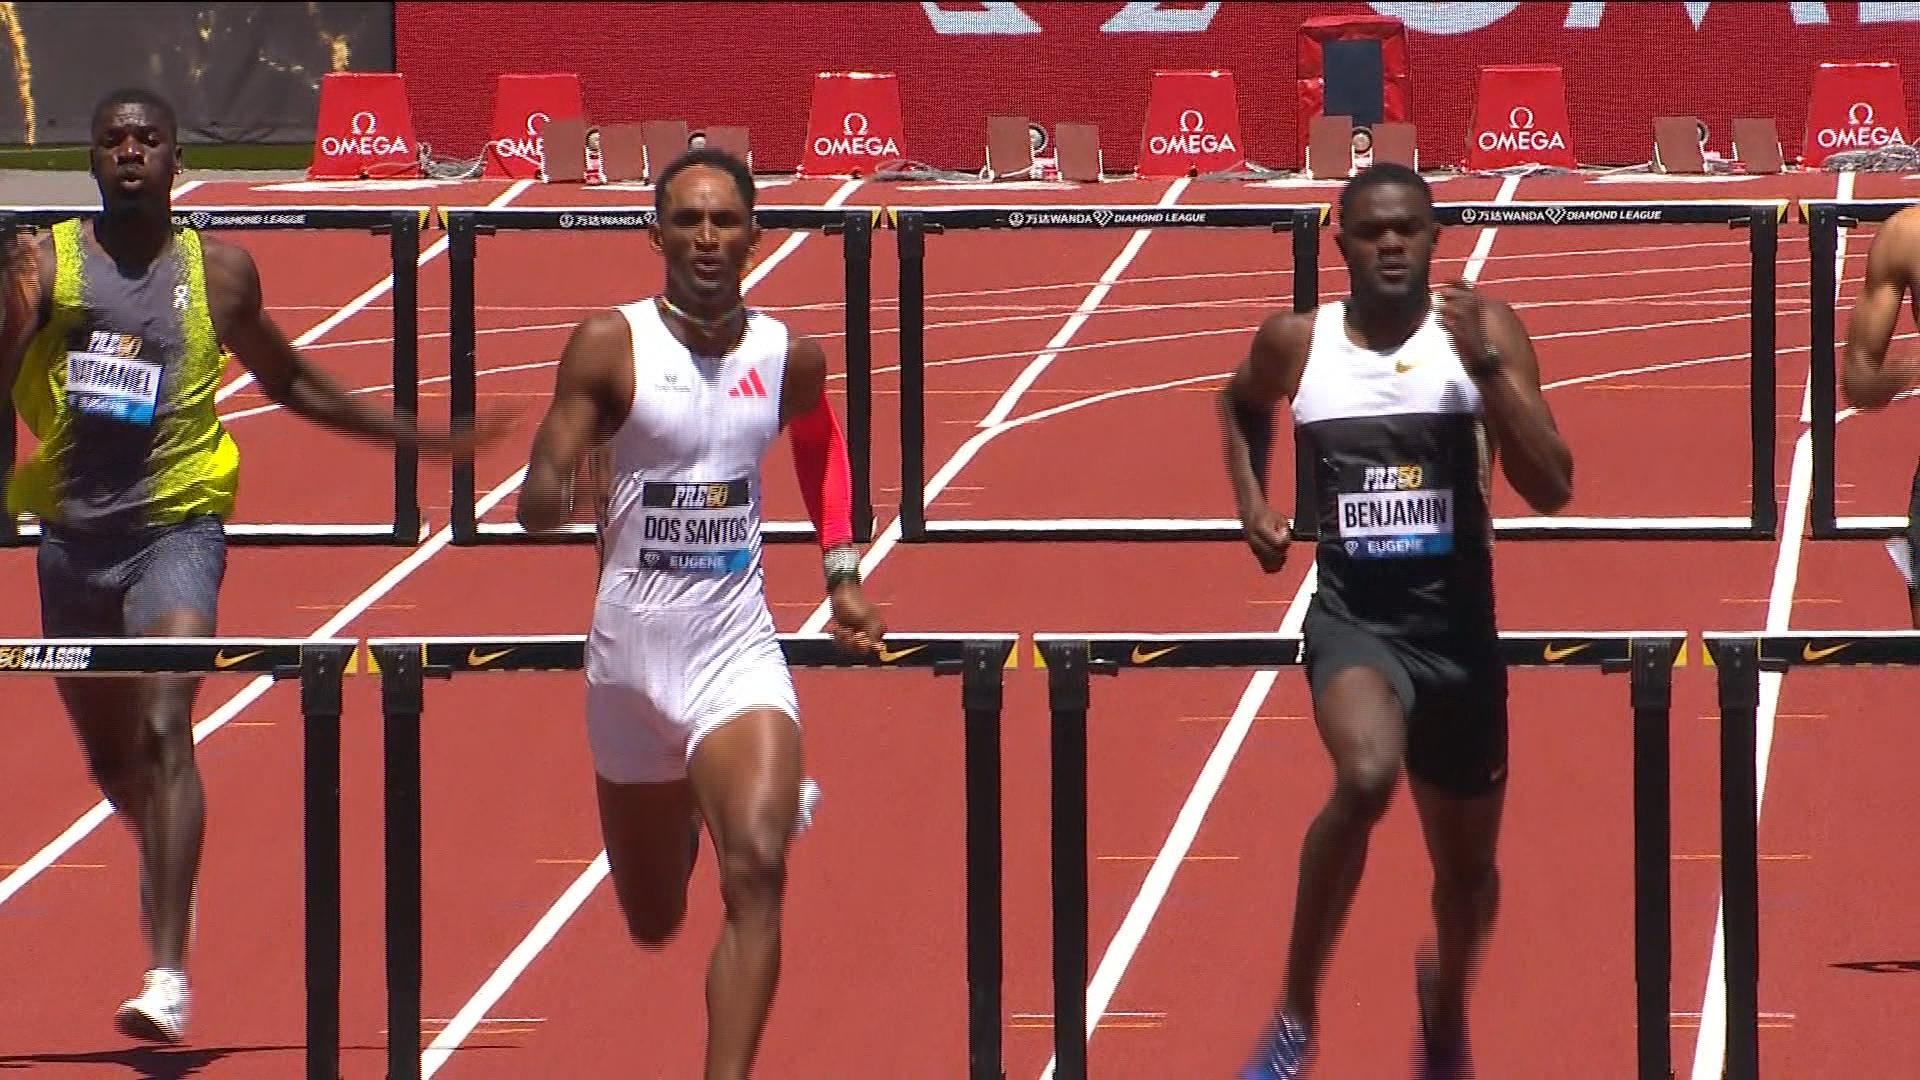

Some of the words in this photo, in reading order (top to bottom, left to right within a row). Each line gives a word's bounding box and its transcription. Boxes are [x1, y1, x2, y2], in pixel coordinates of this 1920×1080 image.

[321, 136, 409, 156] OMEGA
[814, 136, 900, 156] OMEGA
[1149, 134, 1237, 154] OMEGA
[1478, 130, 1566, 151] OMEGA
[1817, 127, 1906, 147] OMEGA
[496, 138, 545, 157] OME
[210, 214, 263, 226] DIAMOND
[263, 213, 306, 225] LEAGUE
[1114, 213, 1163, 223] DIAMOND
[1165, 212, 1206, 223] LEAGUE
[1566, 210, 1617, 221] DIAMOND
[1619, 210, 1662, 220] LEAGUE
[69, 357, 152, 396] NATHANIEL
[1344, 498, 1447, 529] BENJAMIN
[644, 515, 681, 543] DOS
[685, 515, 748, 545] SANTOS
[1367, 539, 1425, 555] EUGENE
[669, 554, 727, 569] EUGENE
